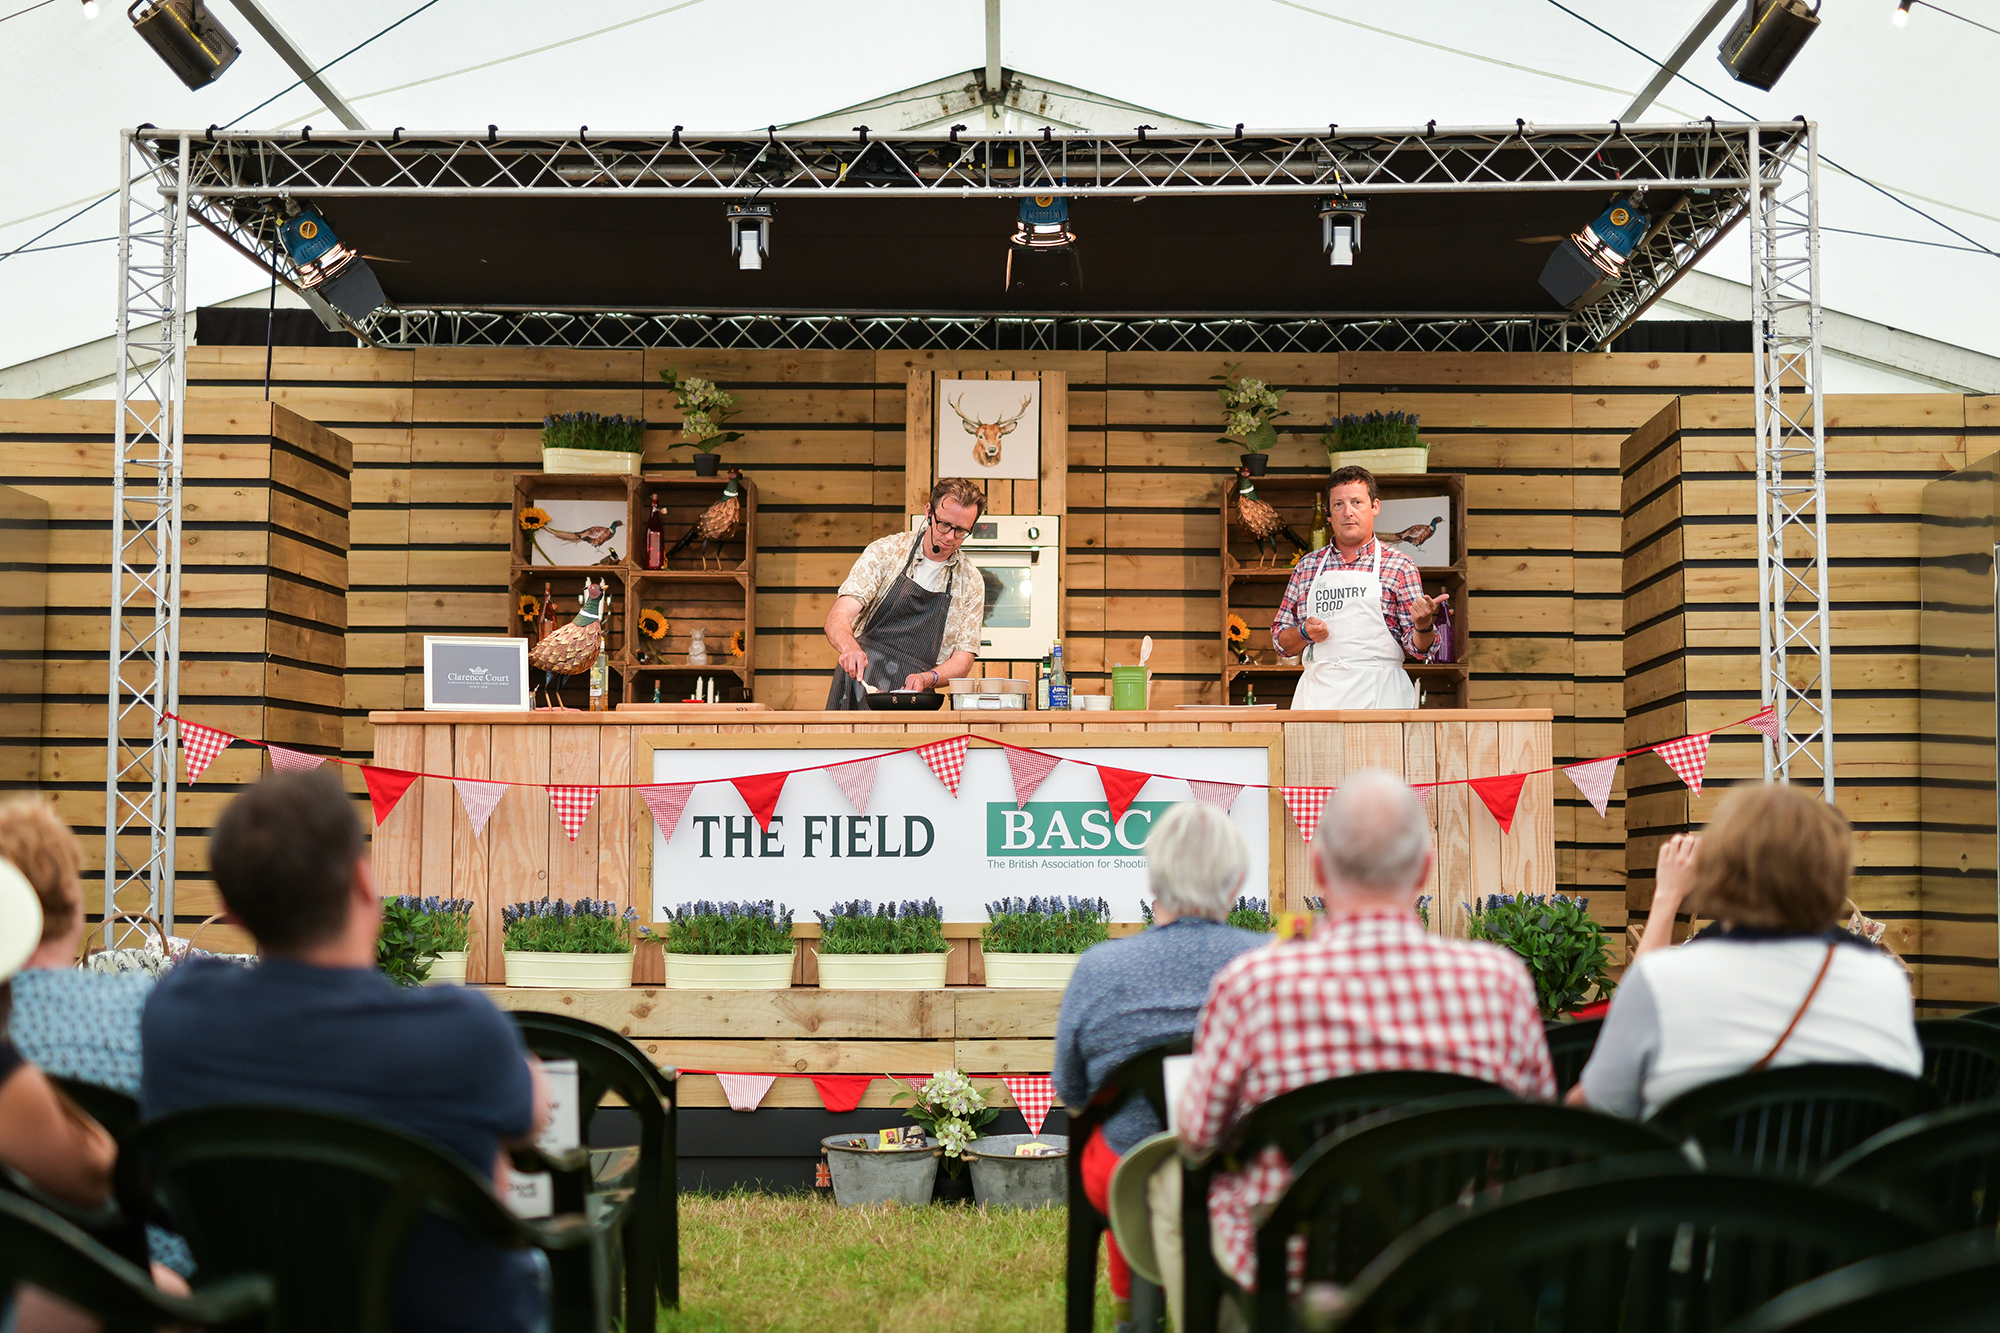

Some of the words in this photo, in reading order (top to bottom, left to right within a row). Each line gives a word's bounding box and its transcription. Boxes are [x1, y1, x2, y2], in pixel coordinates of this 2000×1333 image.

[1315, 587, 1367, 601] COUNTRY
[1315, 600, 1344, 613] FOOD
[447, 672, 484, 681] Clarence
[485, 673, 509, 682] Court
[1000, 809, 1152, 850] BASC
[692, 815, 785, 858] THE
[802, 815, 935, 858] FIELD
[987, 859, 1006, 869] The
[1008, 859, 1038, 869] British
[1041, 859, 1095, 869] Association
[1097, 859, 1111, 869] for
[1113, 859, 1149, 869] Shootin
